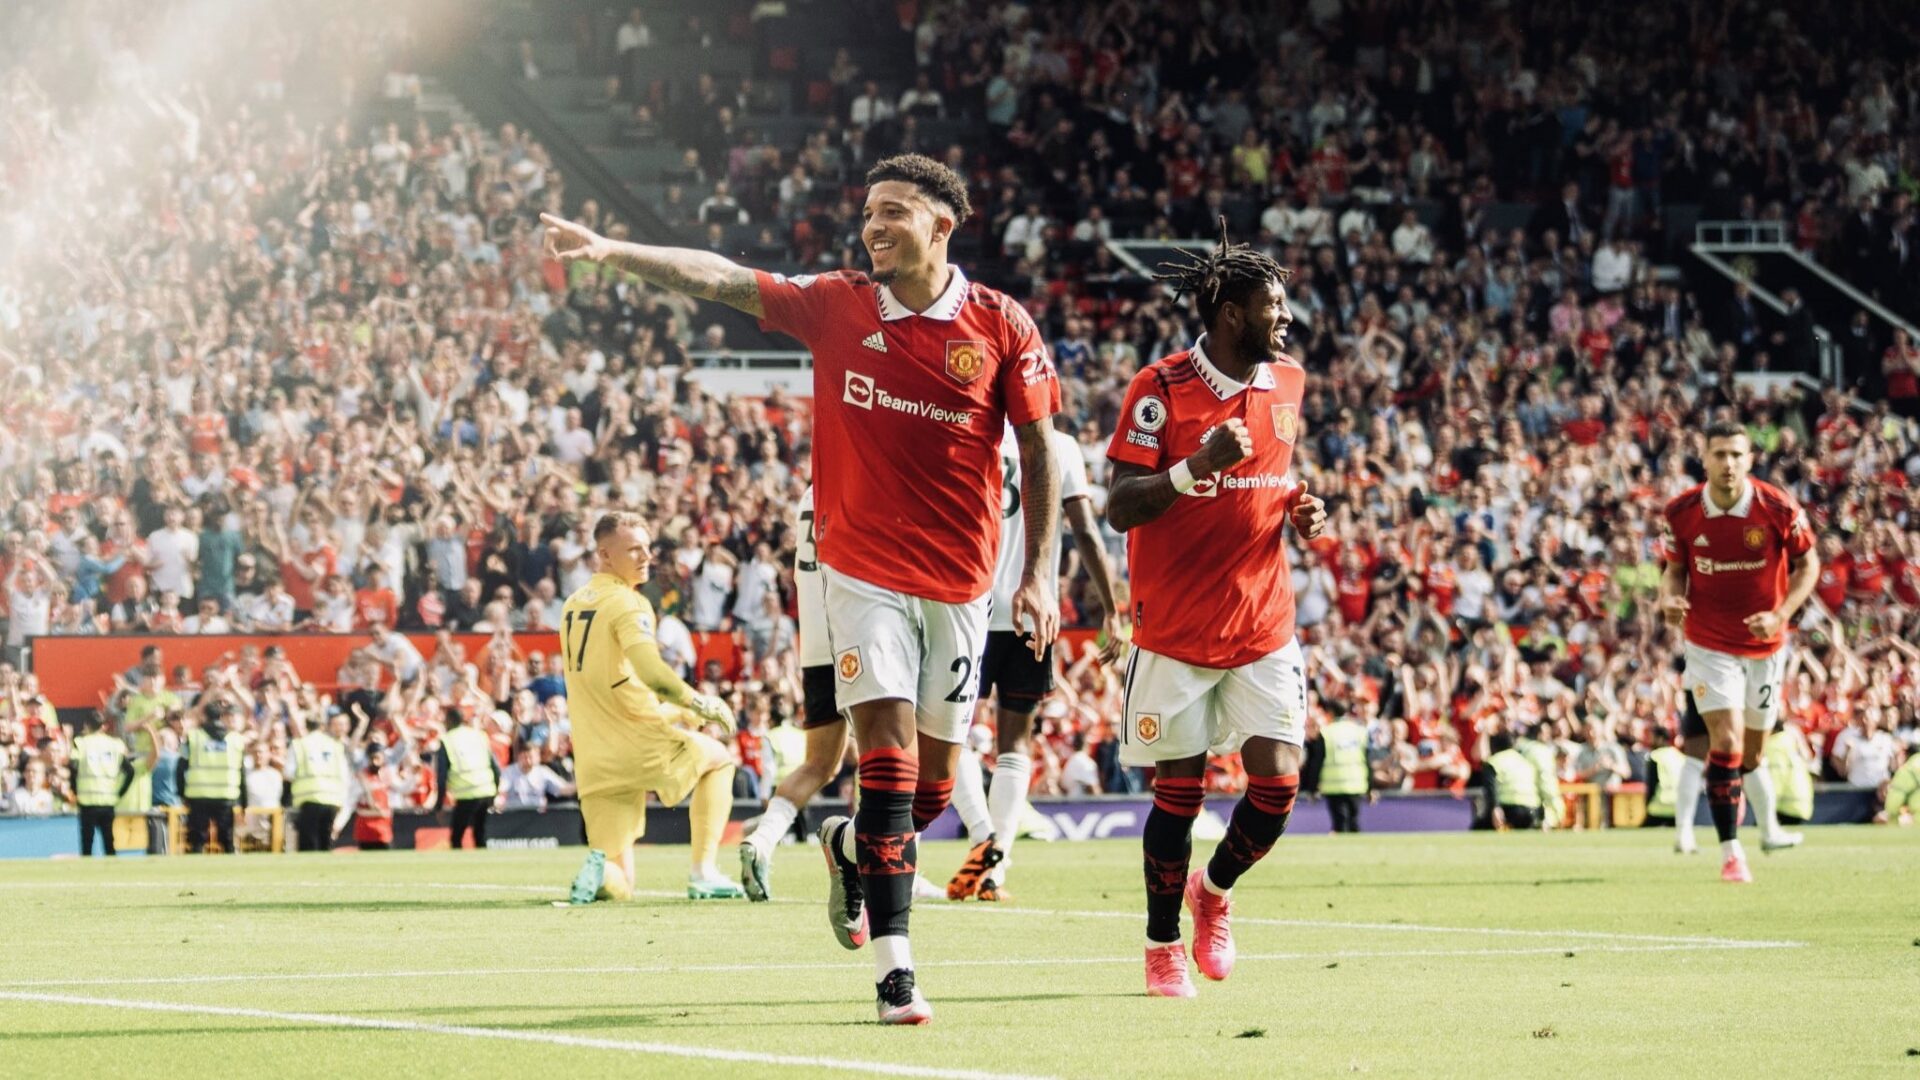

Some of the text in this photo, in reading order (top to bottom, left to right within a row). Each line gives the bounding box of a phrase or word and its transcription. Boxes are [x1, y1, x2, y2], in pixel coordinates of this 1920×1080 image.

[862, 339, 888, 353] adidas
[875, 388, 973, 424] TeamViewer
[1138, 433, 1158, 444] room
[1223, 472, 1290, 489] TeamView
[565, 609, 597, 672] 17
